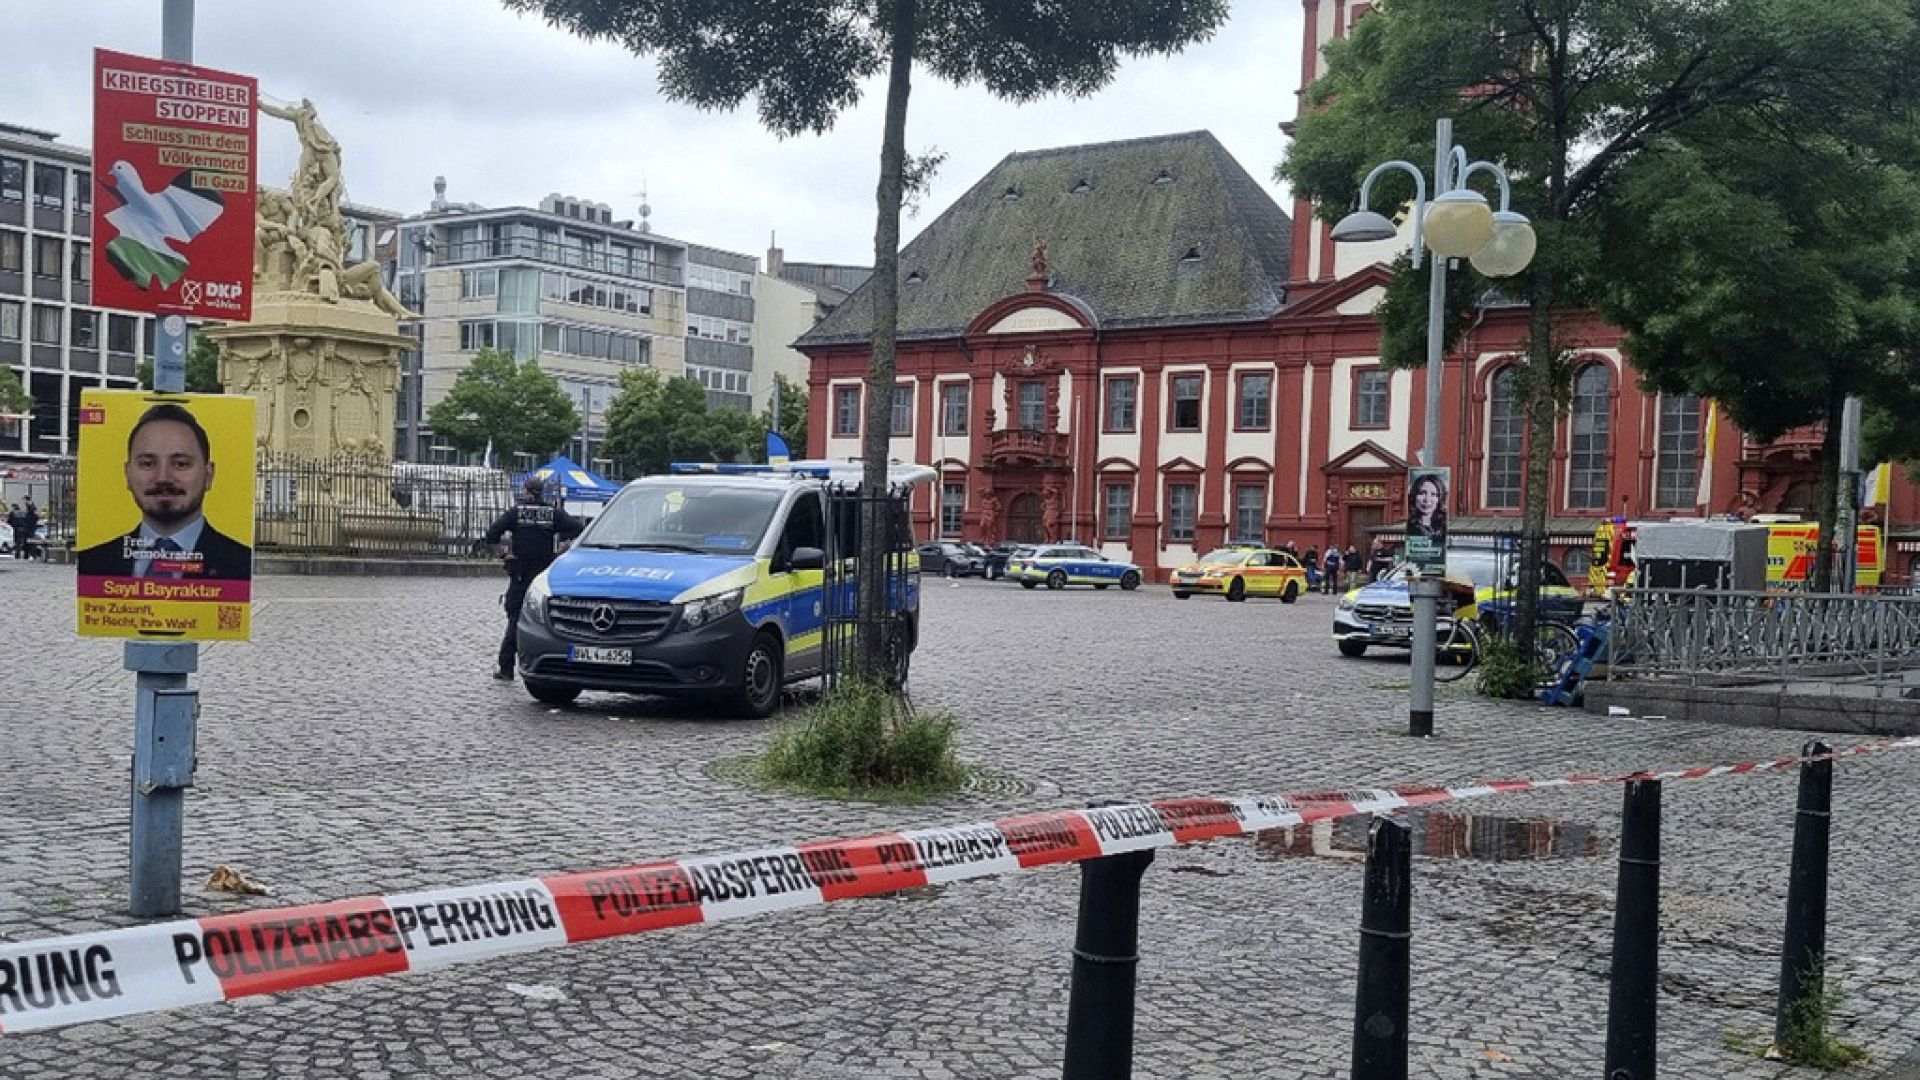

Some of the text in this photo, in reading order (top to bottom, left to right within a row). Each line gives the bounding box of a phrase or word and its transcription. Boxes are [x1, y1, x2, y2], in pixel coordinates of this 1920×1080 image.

[105, 71, 247, 103] KRIEGSTREIBER
[158, 101, 247, 126] STOPPEN!
[125, 125, 246, 150] Schluss mit dem
[161, 150, 246, 170] Völkermord
[194, 173, 246, 190] in Gaza
[205, 281, 243, 299] DKP
[123, 535, 156, 547] Freie
[123, 547, 204, 561] Demokraten
[576, 565, 676, 581] POLIZEI
[143, 582, 222, 599] Bayraktar
[84, 602, 155, 617] Ihre Zukunft,
[84, 614, 100, 625] Ihr
[102, 616, 138, 628] Recht,
[584, 848, 858, 921] POLIZEIABSPERRUNG
[172, 887, 557, 985] POLIZEIABSPERRUNG
